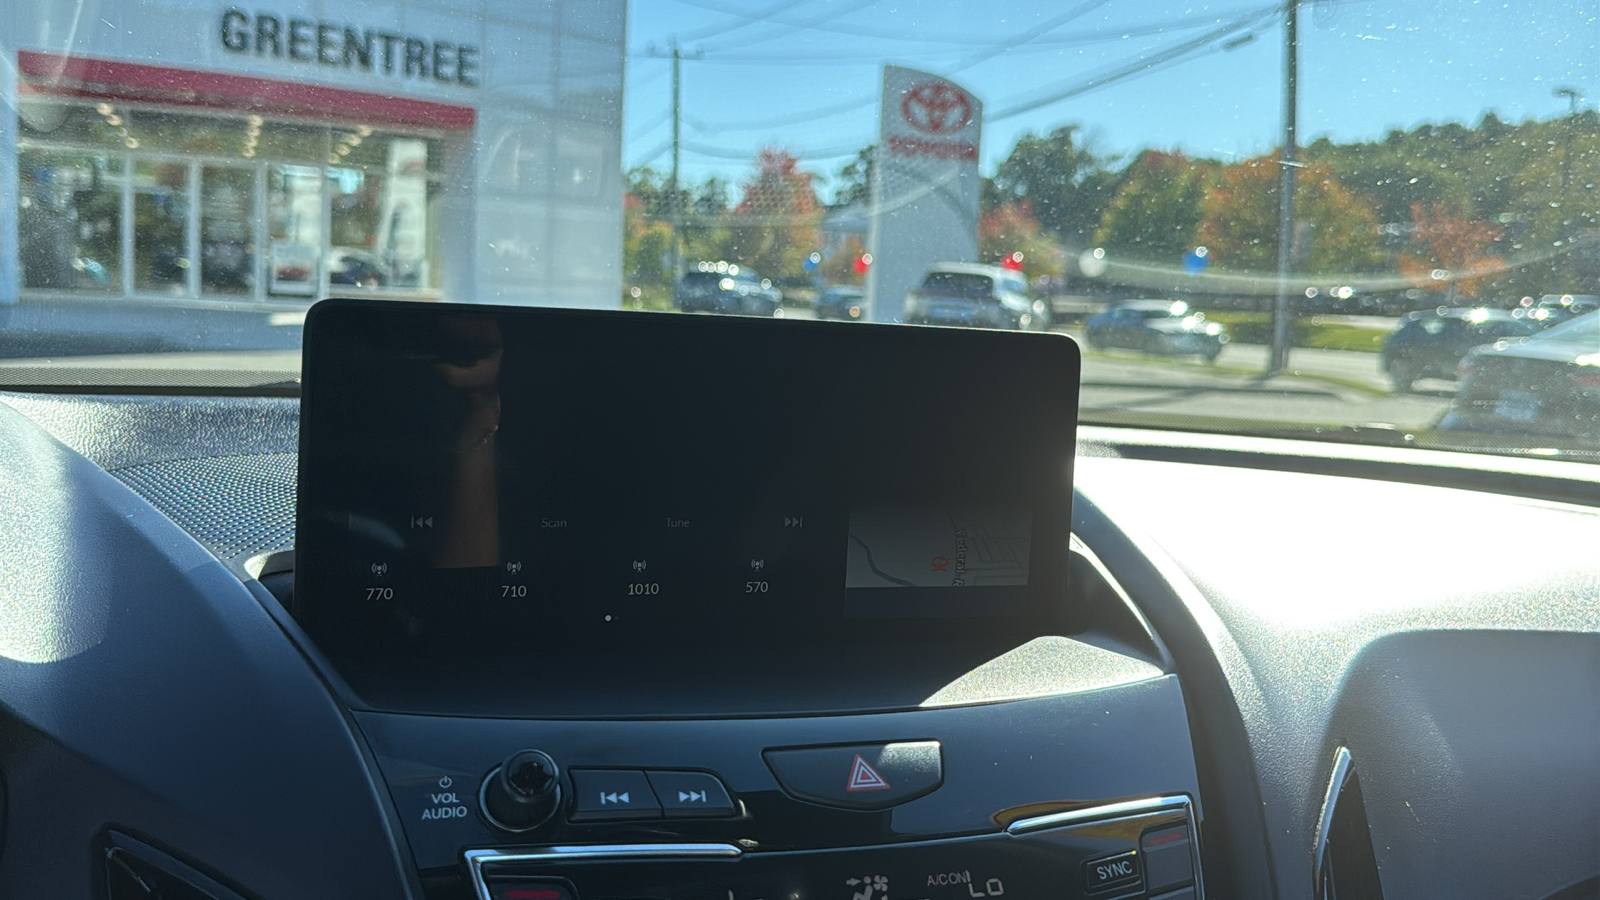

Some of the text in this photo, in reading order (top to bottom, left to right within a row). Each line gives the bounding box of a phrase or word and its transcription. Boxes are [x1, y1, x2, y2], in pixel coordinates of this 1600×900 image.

[222, 9, 480, 87] GREENTREE
[541, 517, 568, 528] Scan
[665, 517, 690, 528] Tune
[955, 529, 968, 574] Federal
[366, 587, 394, 601] 770
[501, 585, 527, 598] 710
[628, 583, 660, 596] 1010
[745, 581, 769, 594] 570
[431, 792, 460, 804] VOL
[421, 806, 468, 820] AUDIO
[1096, 861, 1133, 880] SYNC
